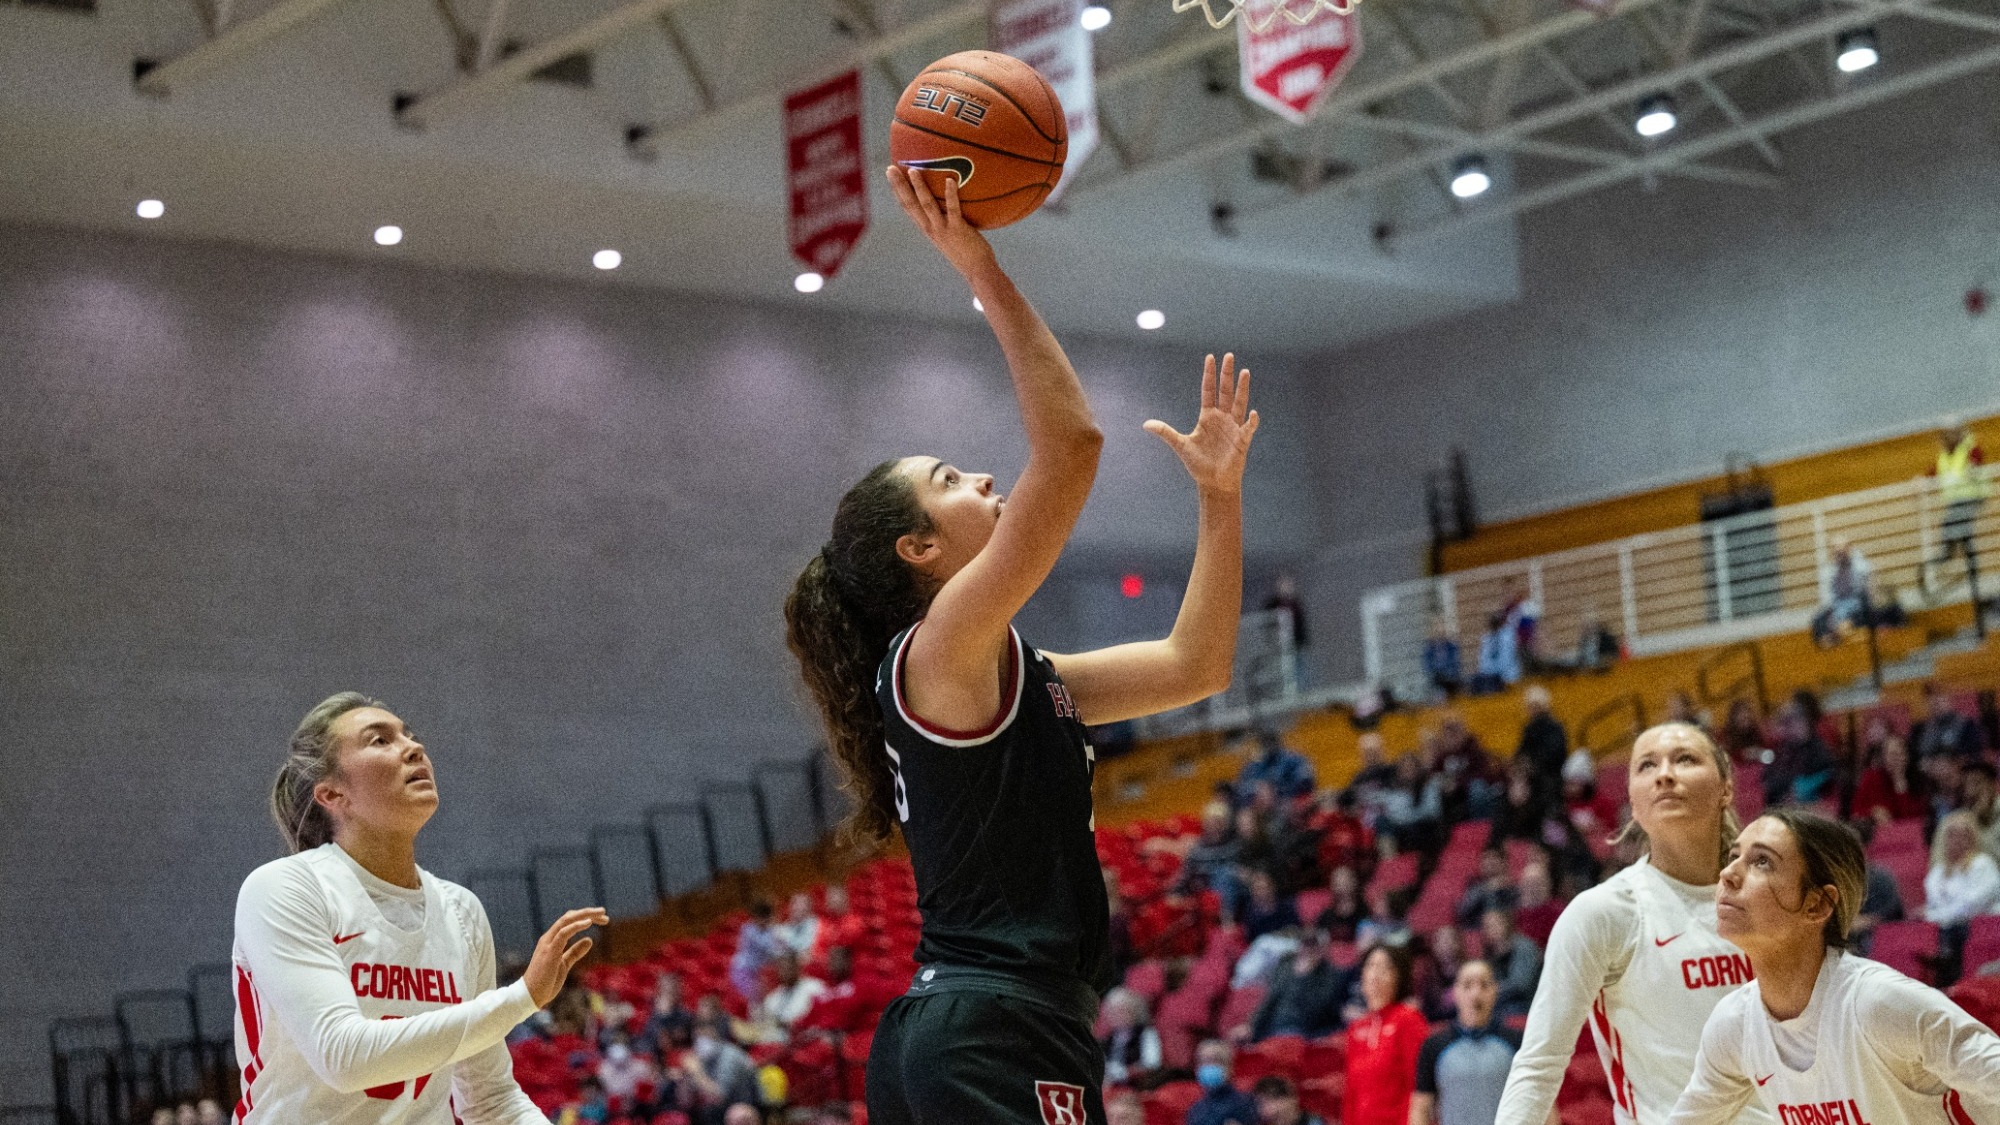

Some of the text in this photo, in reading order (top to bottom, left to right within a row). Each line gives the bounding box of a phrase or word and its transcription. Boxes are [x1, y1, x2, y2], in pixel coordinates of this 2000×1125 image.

[912, 87, 988, 128] ELITE
[1046, 683, 1081, 722] HA
[350, 962, 463, 1005] CORNELL
[1778, 1098, 1872, 1125] CORNELL
